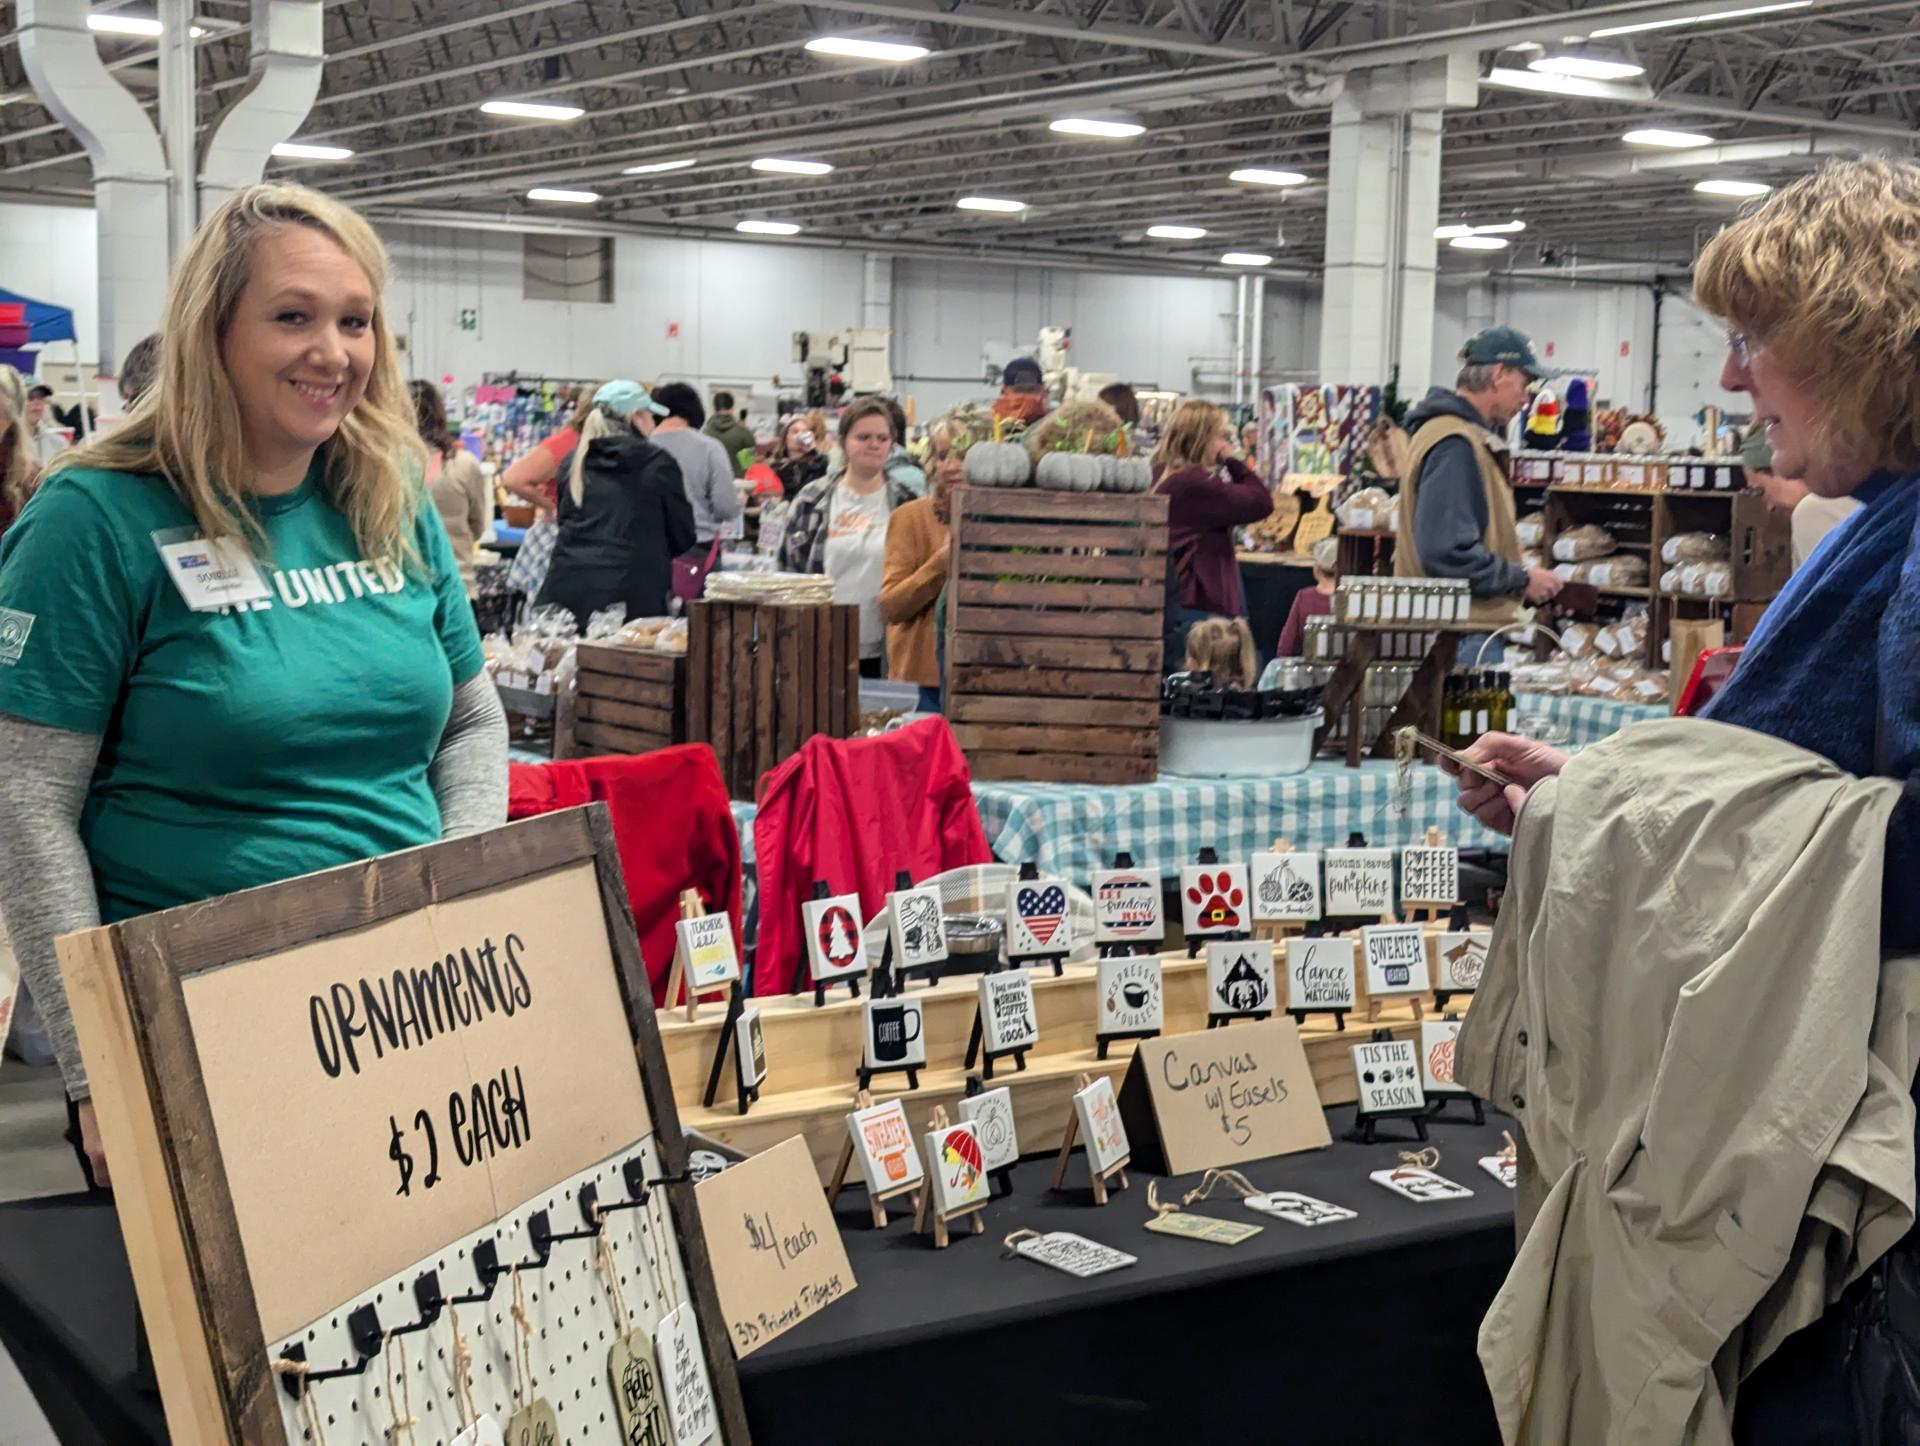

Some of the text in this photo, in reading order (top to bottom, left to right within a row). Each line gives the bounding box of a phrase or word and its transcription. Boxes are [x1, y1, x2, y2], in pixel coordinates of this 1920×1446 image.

[273, 555, 405, 608] UNITED
[1370, 935, 1422, 966] SWEATER
[1304, 988, 1351, 1002] WATCHING
[878, 1020, 901, 1043] COFFEE
[1383, 1043, 1409, 1062] THE
[1163, 1050, 1258, 1091] Canvas
[1371, 1086, 1417, 1107] SEASON
[389, 1109, 441, 1197] $2
[783, 1221, 818, 1261] each
[735, 1321, 760, 1345] 3D
[757, 1299, 802, 1335] Printed
